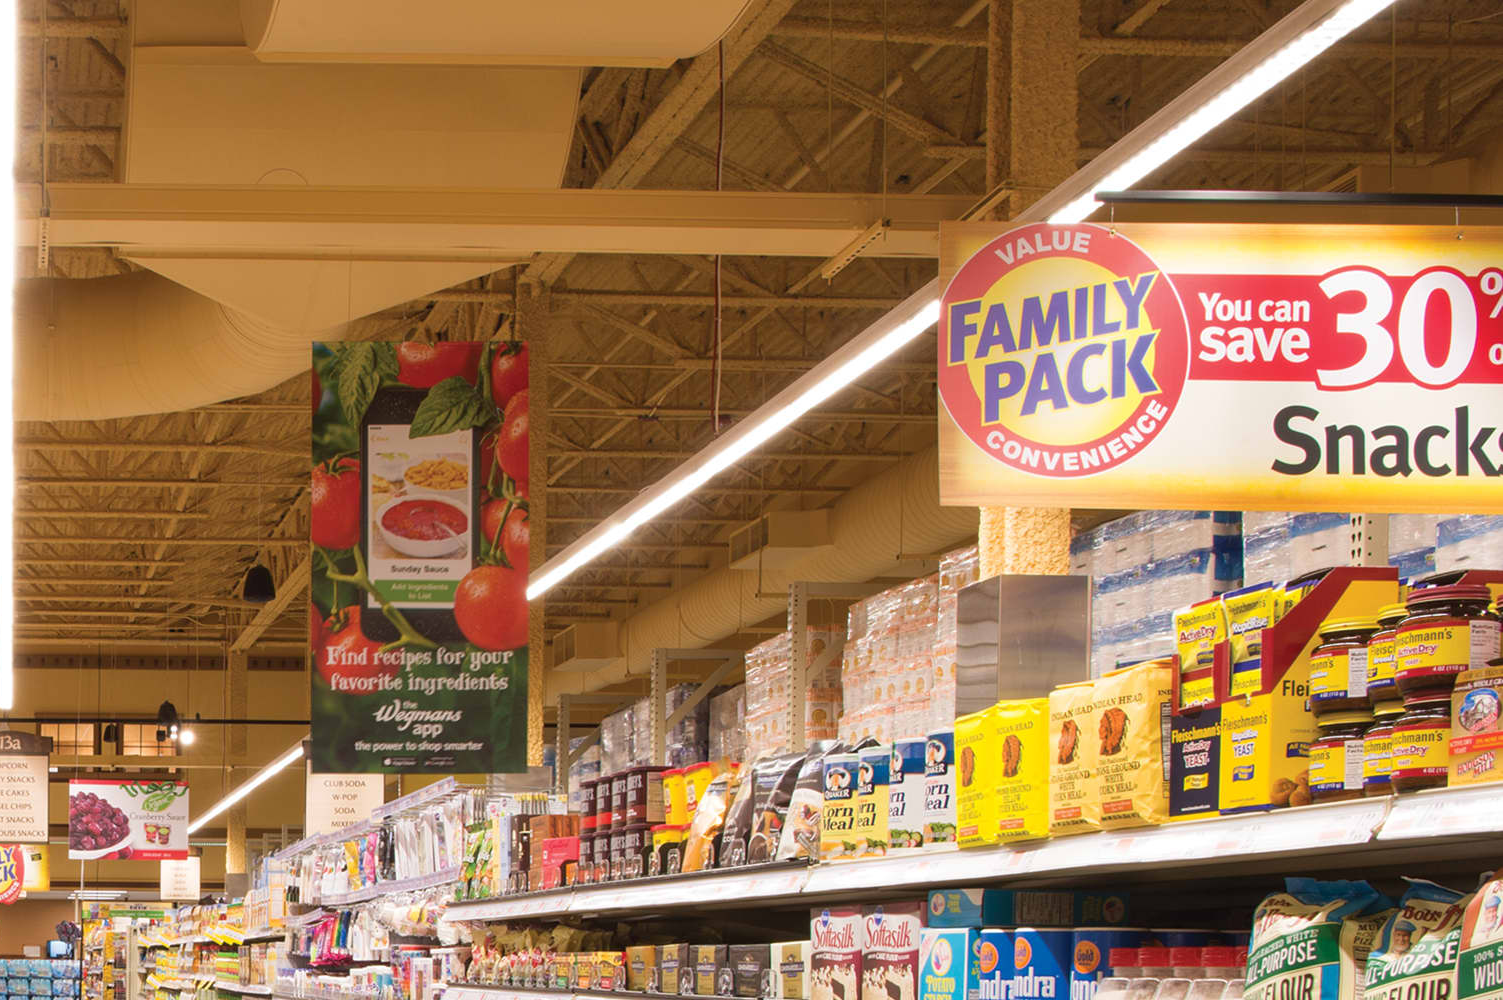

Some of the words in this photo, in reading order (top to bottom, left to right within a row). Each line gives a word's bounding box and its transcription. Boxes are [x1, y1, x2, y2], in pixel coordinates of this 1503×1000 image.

[995, 230, 1092, 266] VALUE
[949, 271, 1159, 365] FAMILY
[1198, 292, 1252, 323] You
[1258, 296, 1310, 323] can
[1198, 326, 1310, 363] save
[983, 331, 1160, 425] PACK
[986, 400, 1168, 472] CONVENIENCE
[391, 565, 421, 575] Sunday
[424, 565, 449, 573] Sauce
[326, 646, 367, 666] Find
[372, 649, 432, 671] recipes
[436, 647, 465, 665] for
[470, 650, 513, 670] your
[330, 673, 403, 691] favorite
[407, 672, 509, 696] ingredients
[372, 699, 462, 731] Wegmans
[402, 700, 417, 709] the
[412, 723, 443, 738] app
[1171, 721, 1222, 744] Fleischmann's
[1223, 711, 1268, 731] Fleischmann's
[355, 741, 371, 750] the
[372, 742, 403, 753] power
[405, 741, 417, 750] to
[418, 741, 442, 753] shop
[444, 742, 484, 751] smarter
[130, 813, 165, 823] Cranberry
[812, 918, 855, 950] Softasilk
[864, 918, 912, 950] Softasilk
[926, 974, 956, 992] POTATO
